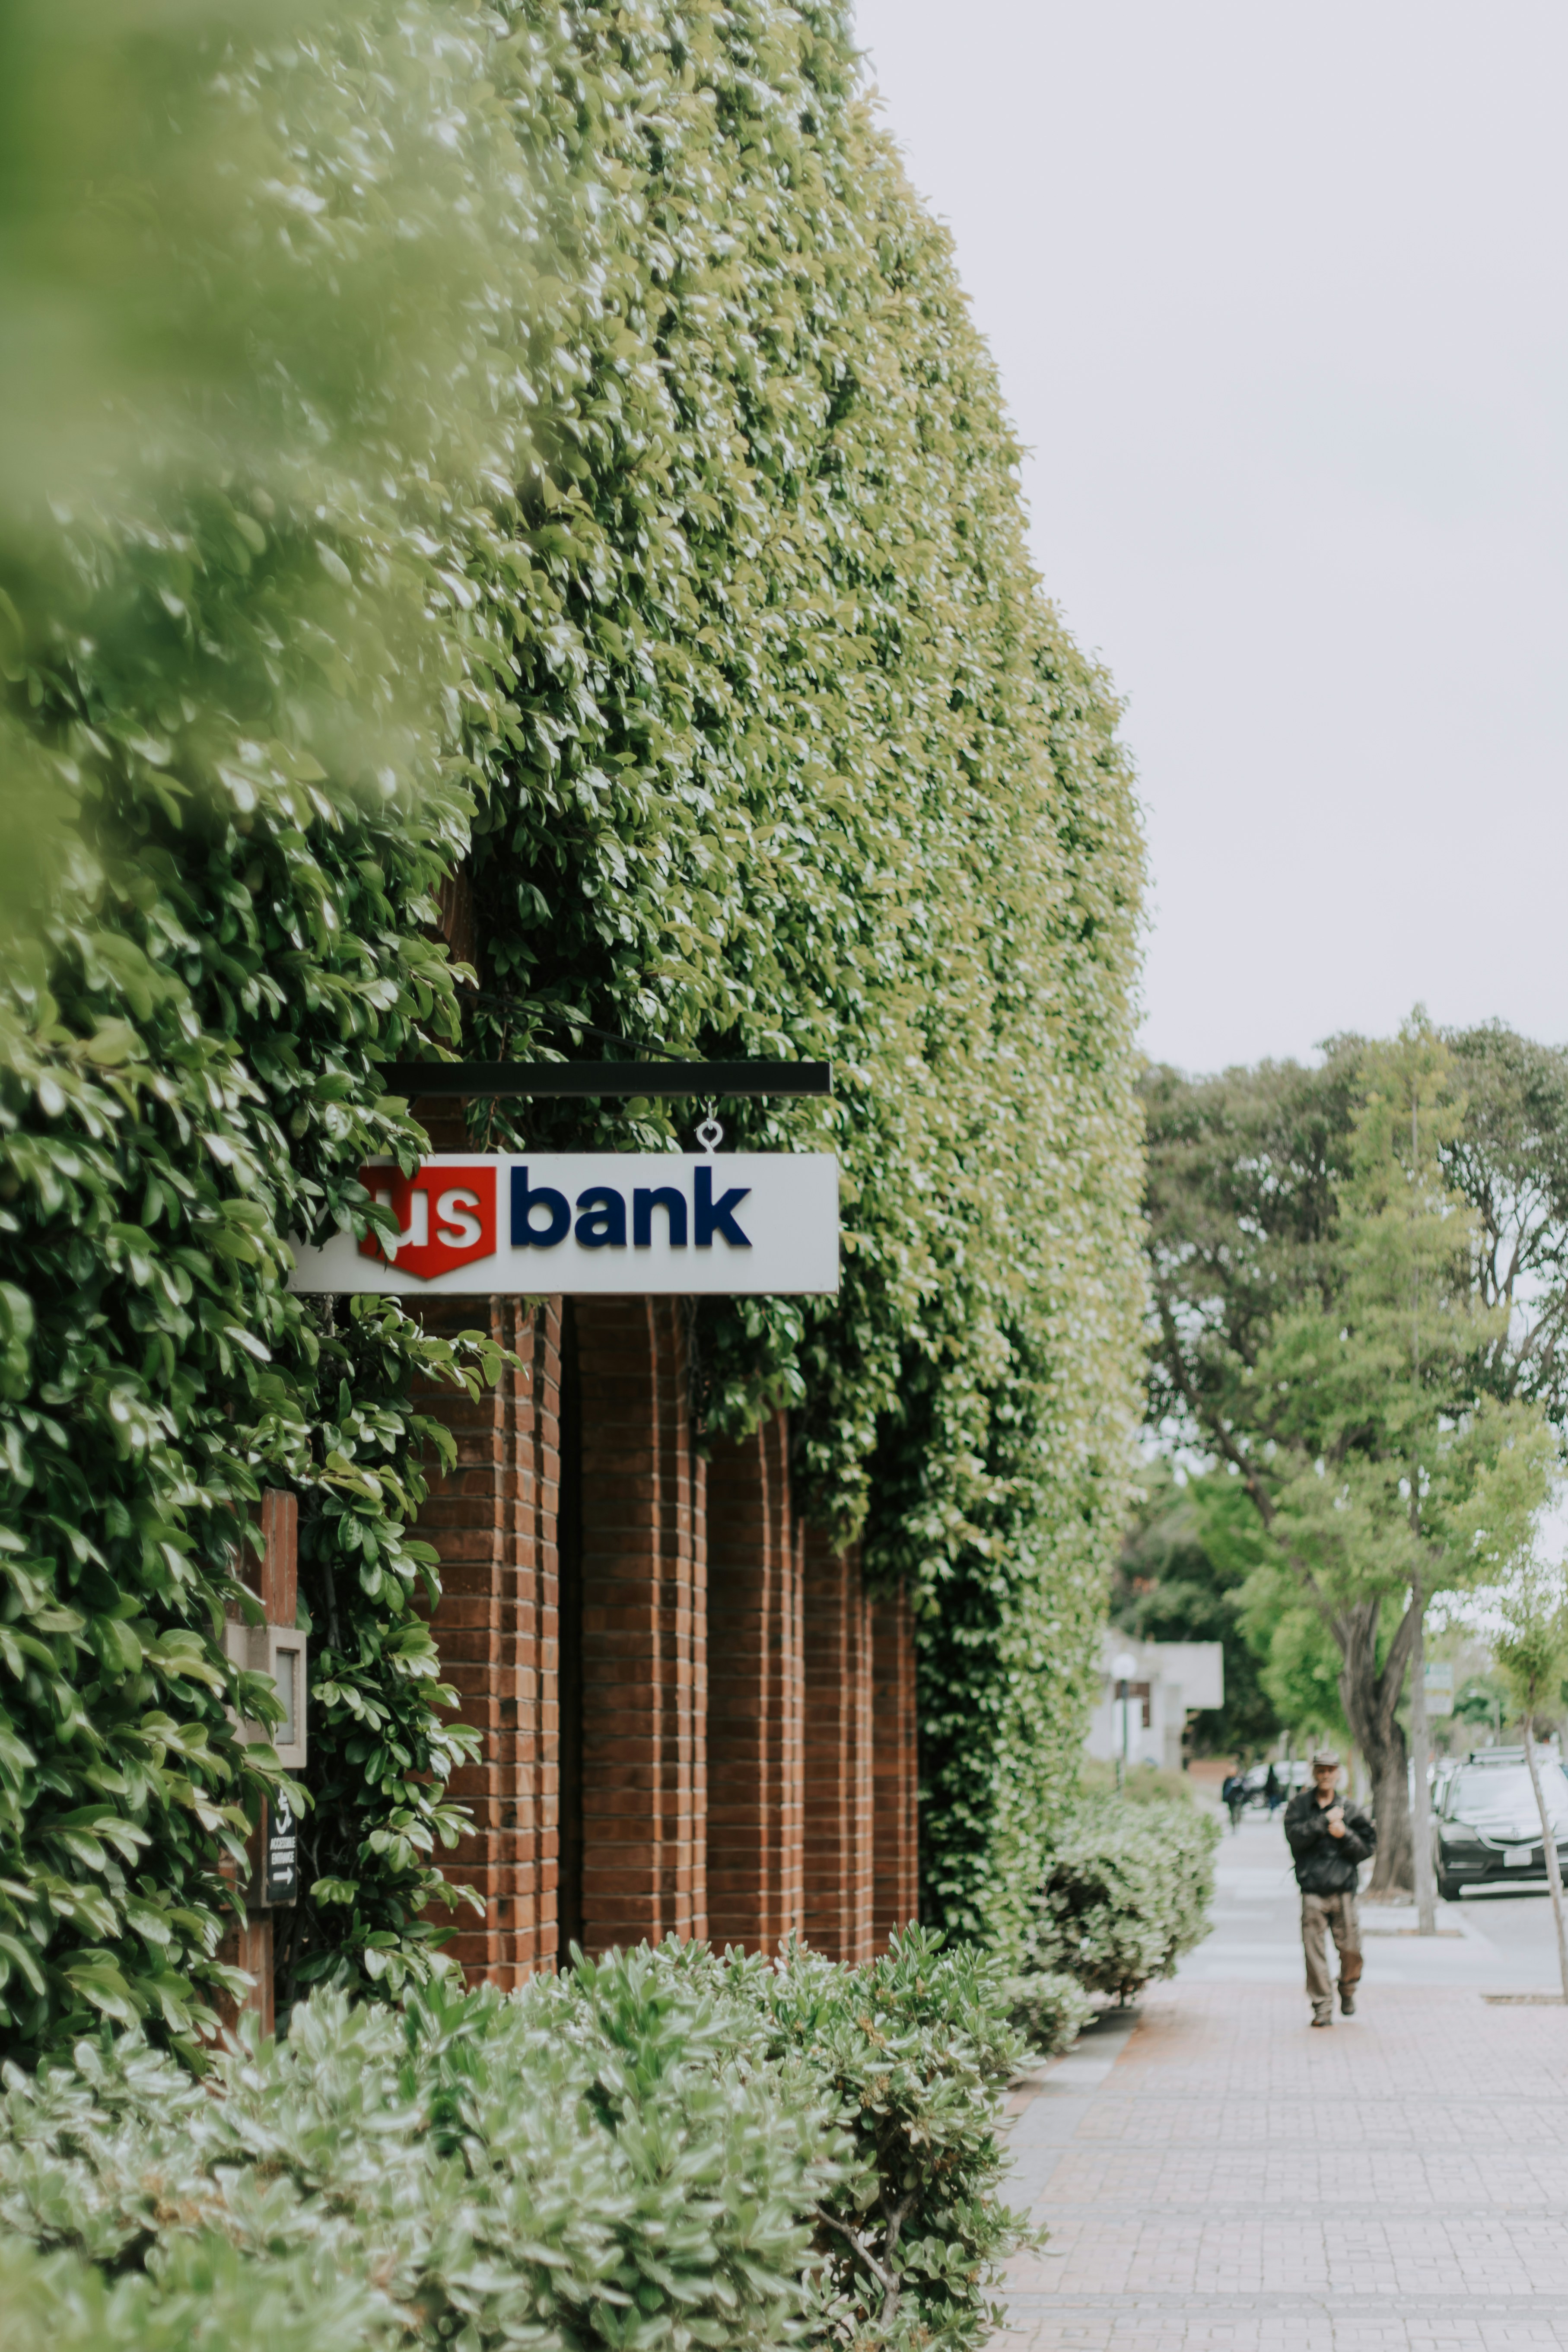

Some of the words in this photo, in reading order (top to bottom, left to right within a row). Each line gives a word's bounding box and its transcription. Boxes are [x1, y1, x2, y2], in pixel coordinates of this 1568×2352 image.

[511, 1166, 752, 1247] bank
[270, 1836, 296, 1850] ACCESSIBLE
[271, 1851, 294, 1865] ENTRANCE
